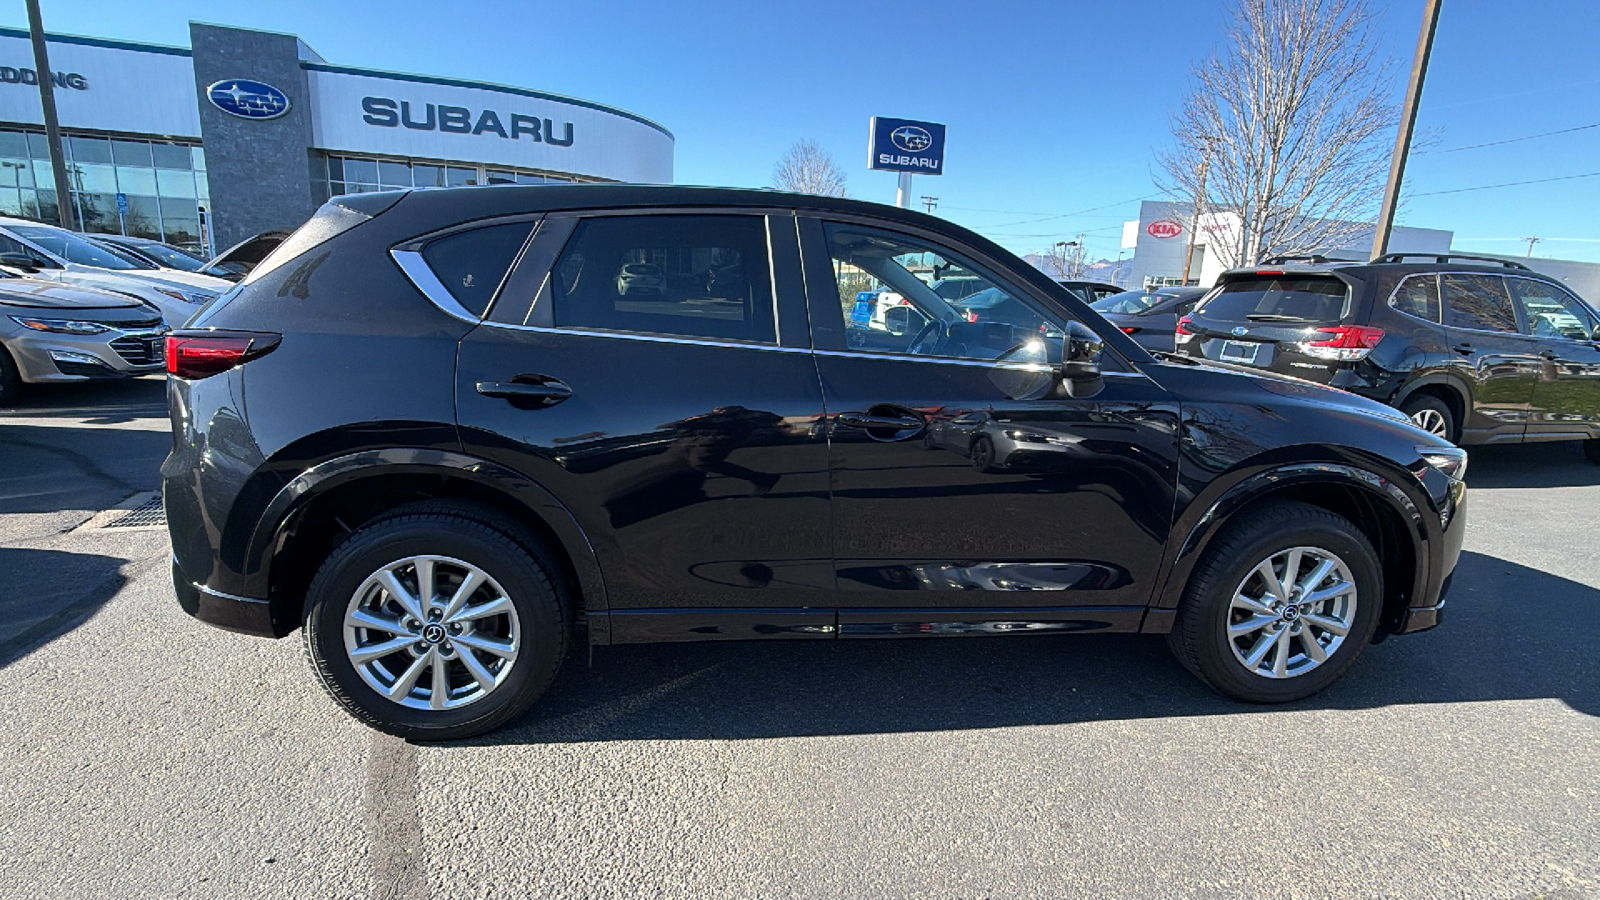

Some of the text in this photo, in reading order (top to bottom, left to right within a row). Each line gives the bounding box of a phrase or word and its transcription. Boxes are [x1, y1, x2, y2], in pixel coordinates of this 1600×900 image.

[0, 66, 88, 90] DDNG
[361, 96, 574, 147] SUBARU
[879, 153, 939, 169] SUBARU
[1152, 224, 1176, 235] KIA
